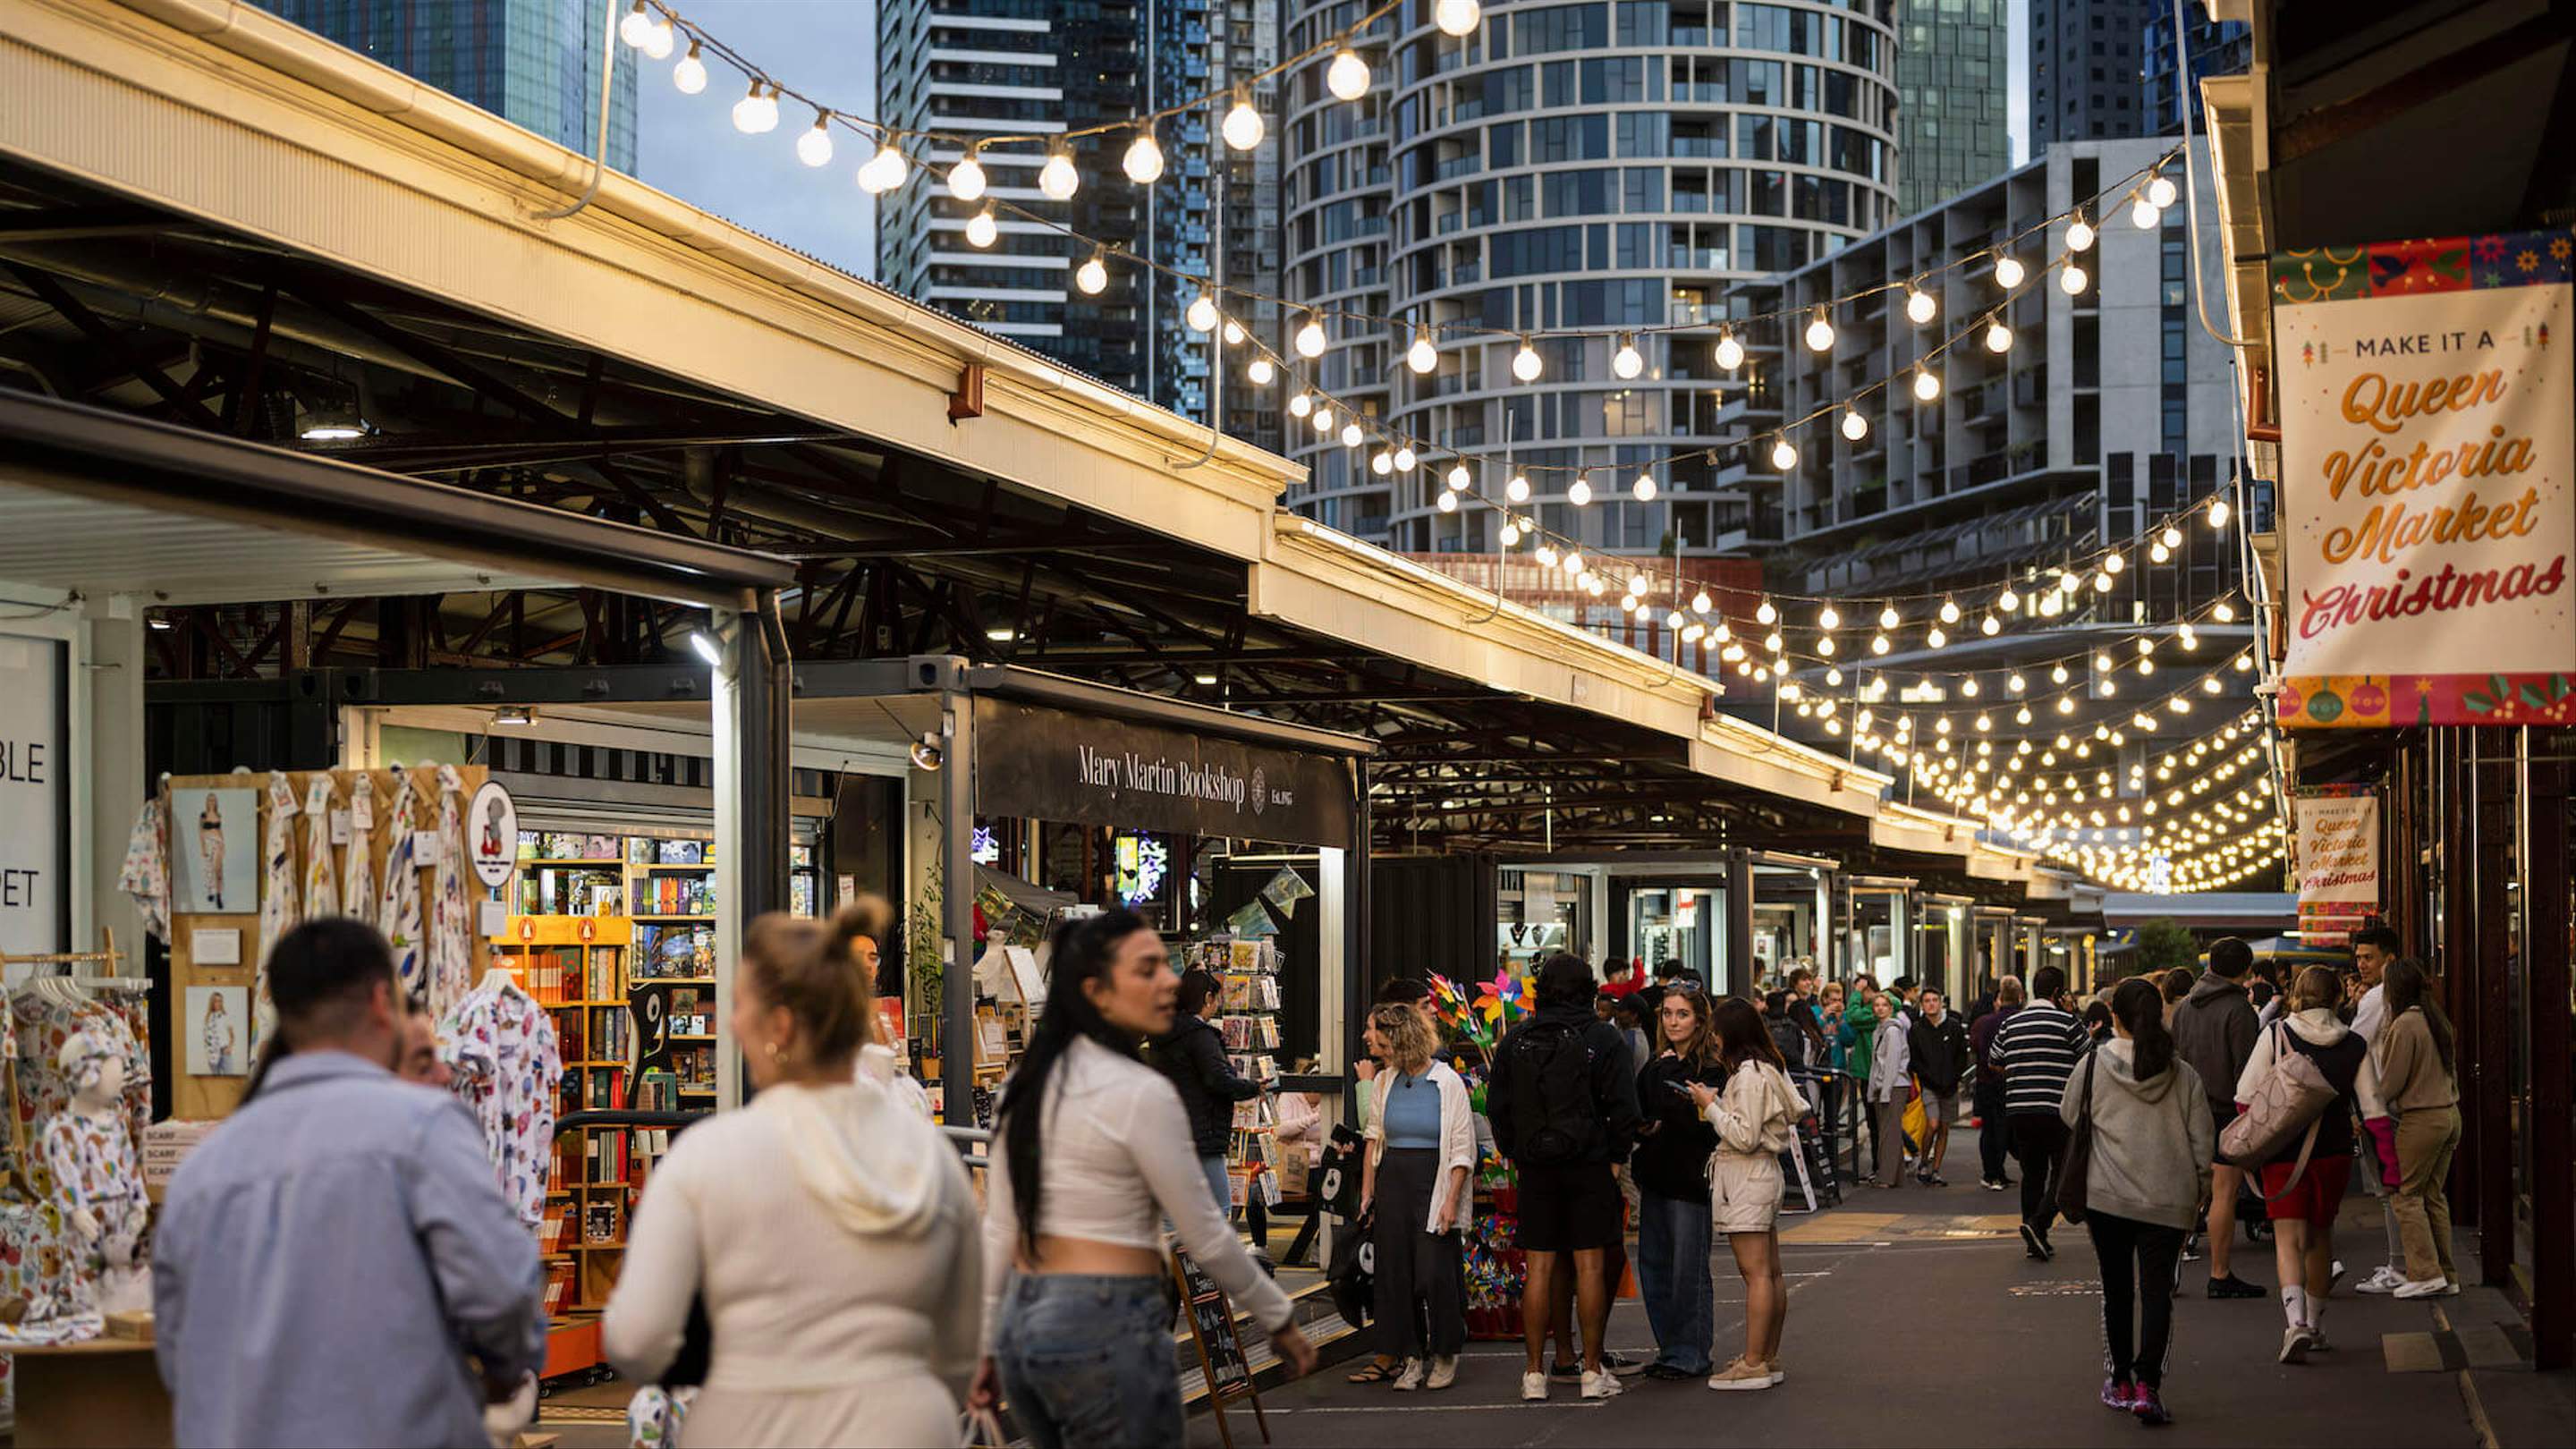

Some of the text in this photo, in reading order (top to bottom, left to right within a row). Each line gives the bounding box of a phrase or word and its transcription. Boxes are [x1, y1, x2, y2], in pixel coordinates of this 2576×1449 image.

[2356, 330, 2495, 358] MAKE IT A
[2341, 367, 2507, 434] Queen
[2322, 424, 2537, 502] Victoria
[2322, 487, 2539, 564] Market
[2299, 555, 2566, 639] Christmas
[1078, 743, 1245, 814] Mary Martin Bookshop
[2310, 834, 2368, 853] Victoria
[2315, 818, 2361, 835] Queen
[2303, 869, 2377, 891] Christmas
[2309, 852, 2368, 871] Market
[0, 869, 39, 907] ET
